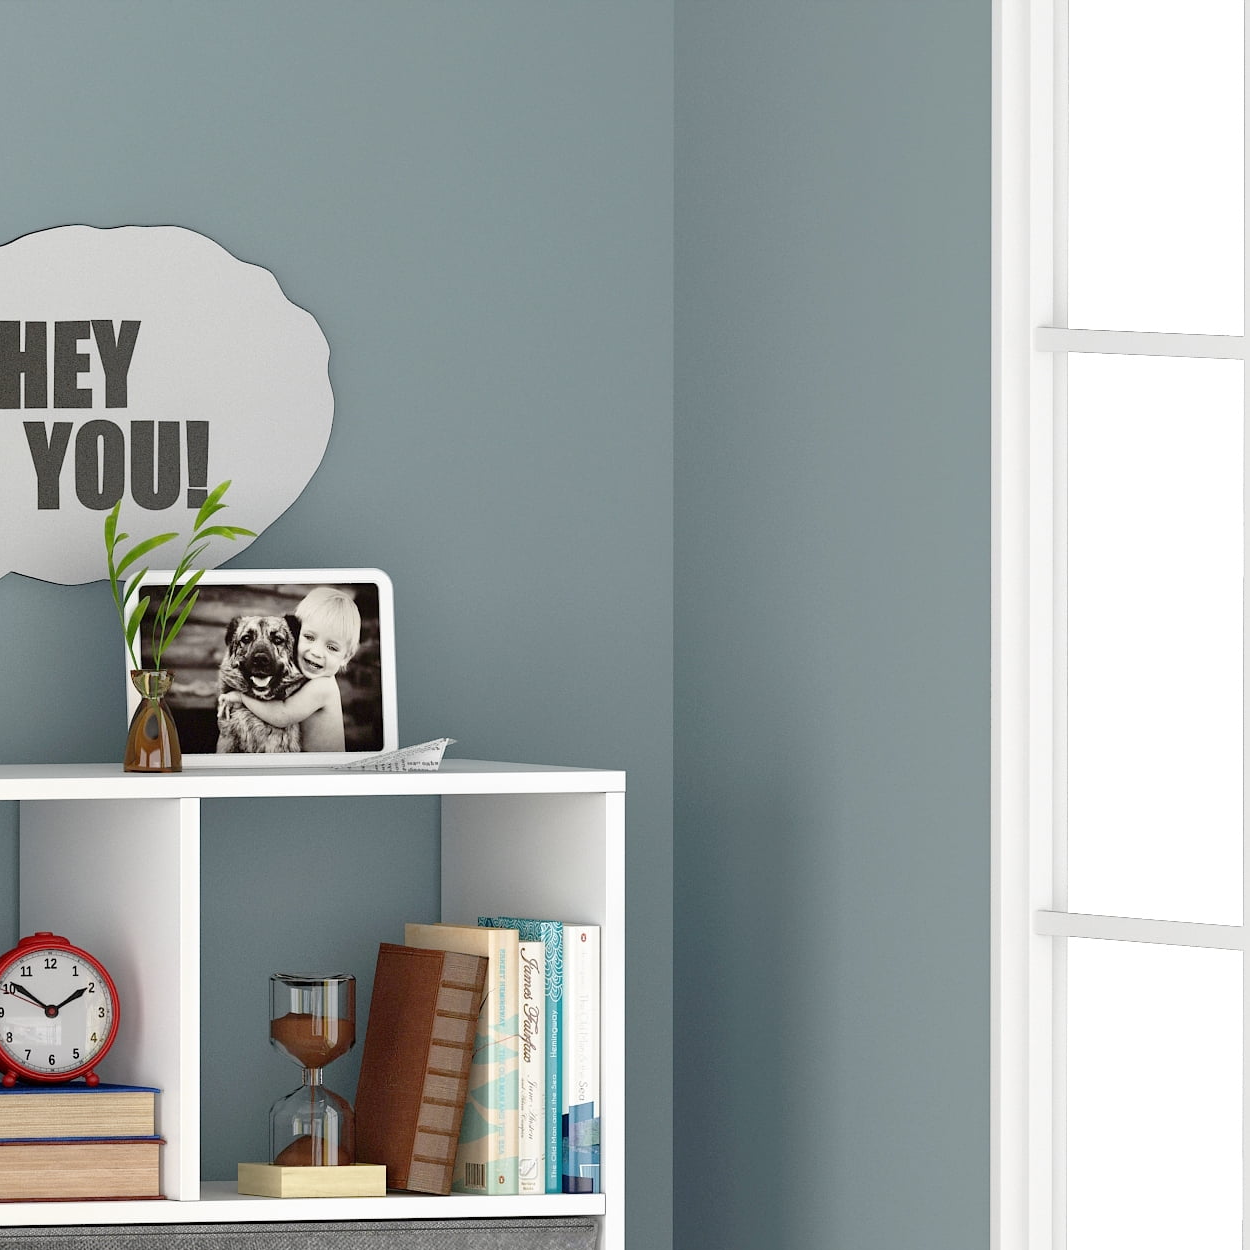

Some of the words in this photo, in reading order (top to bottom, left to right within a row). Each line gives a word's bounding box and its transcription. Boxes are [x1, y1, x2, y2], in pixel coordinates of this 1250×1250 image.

[23, 419, 209, 510] YOU!
[44, 958, 57, 969] 12
[20, 966, 32, 976] 11
[72, 966, 78, 976] 1
[520, 948, 540, 1000] James
[3, 983, 15, 995] 10
[88, 983, 95, 993] 2
[98, 1007, 105, 1018] 3
[6, 1032, 13, 1042] 8
[90, 1032, 97, 1042] 4
[520, 1003, 540, 1063] Fairfax
[550, 1009, 558, 1058] Hemingway
[24, 1050, 31, 1060] 7
[73, 1048, 80, 1059] 5
[49, 1055, 55, 1065] 6
[579, 1081, 588, 1101] Sea
